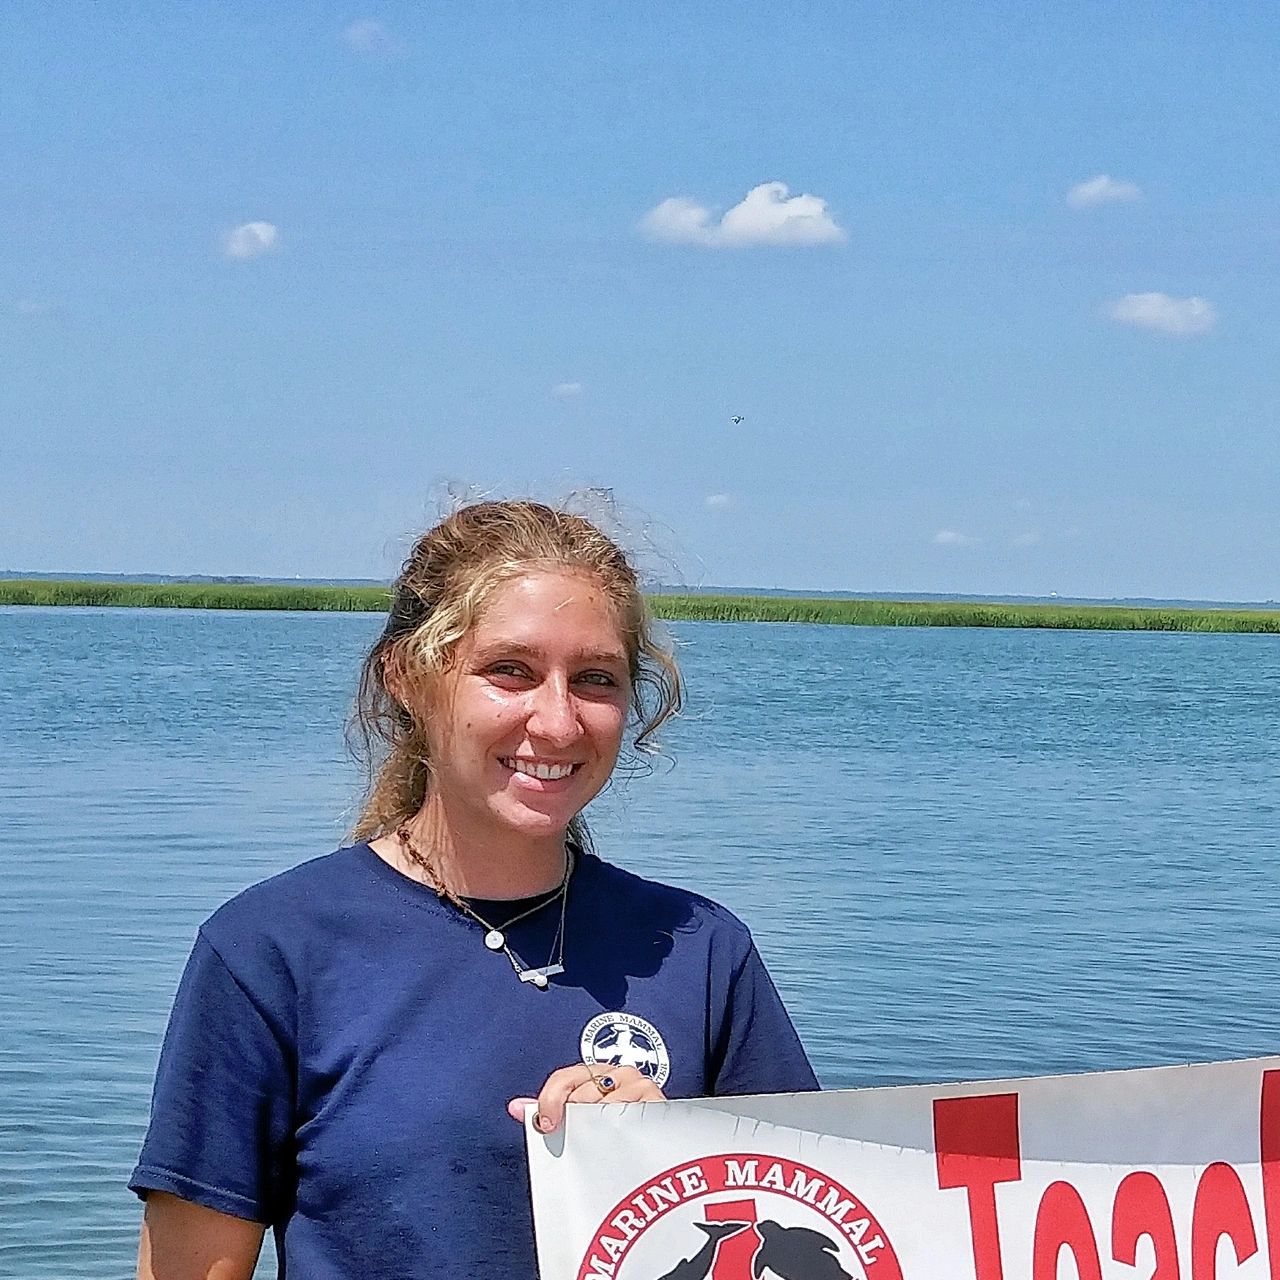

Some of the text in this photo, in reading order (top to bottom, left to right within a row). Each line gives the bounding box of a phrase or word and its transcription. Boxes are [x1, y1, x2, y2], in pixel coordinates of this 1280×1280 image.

[583, 1014, 664, 1051] MARINE MAMMAL
[723, 1159, 886, 1265] MAMMAL
